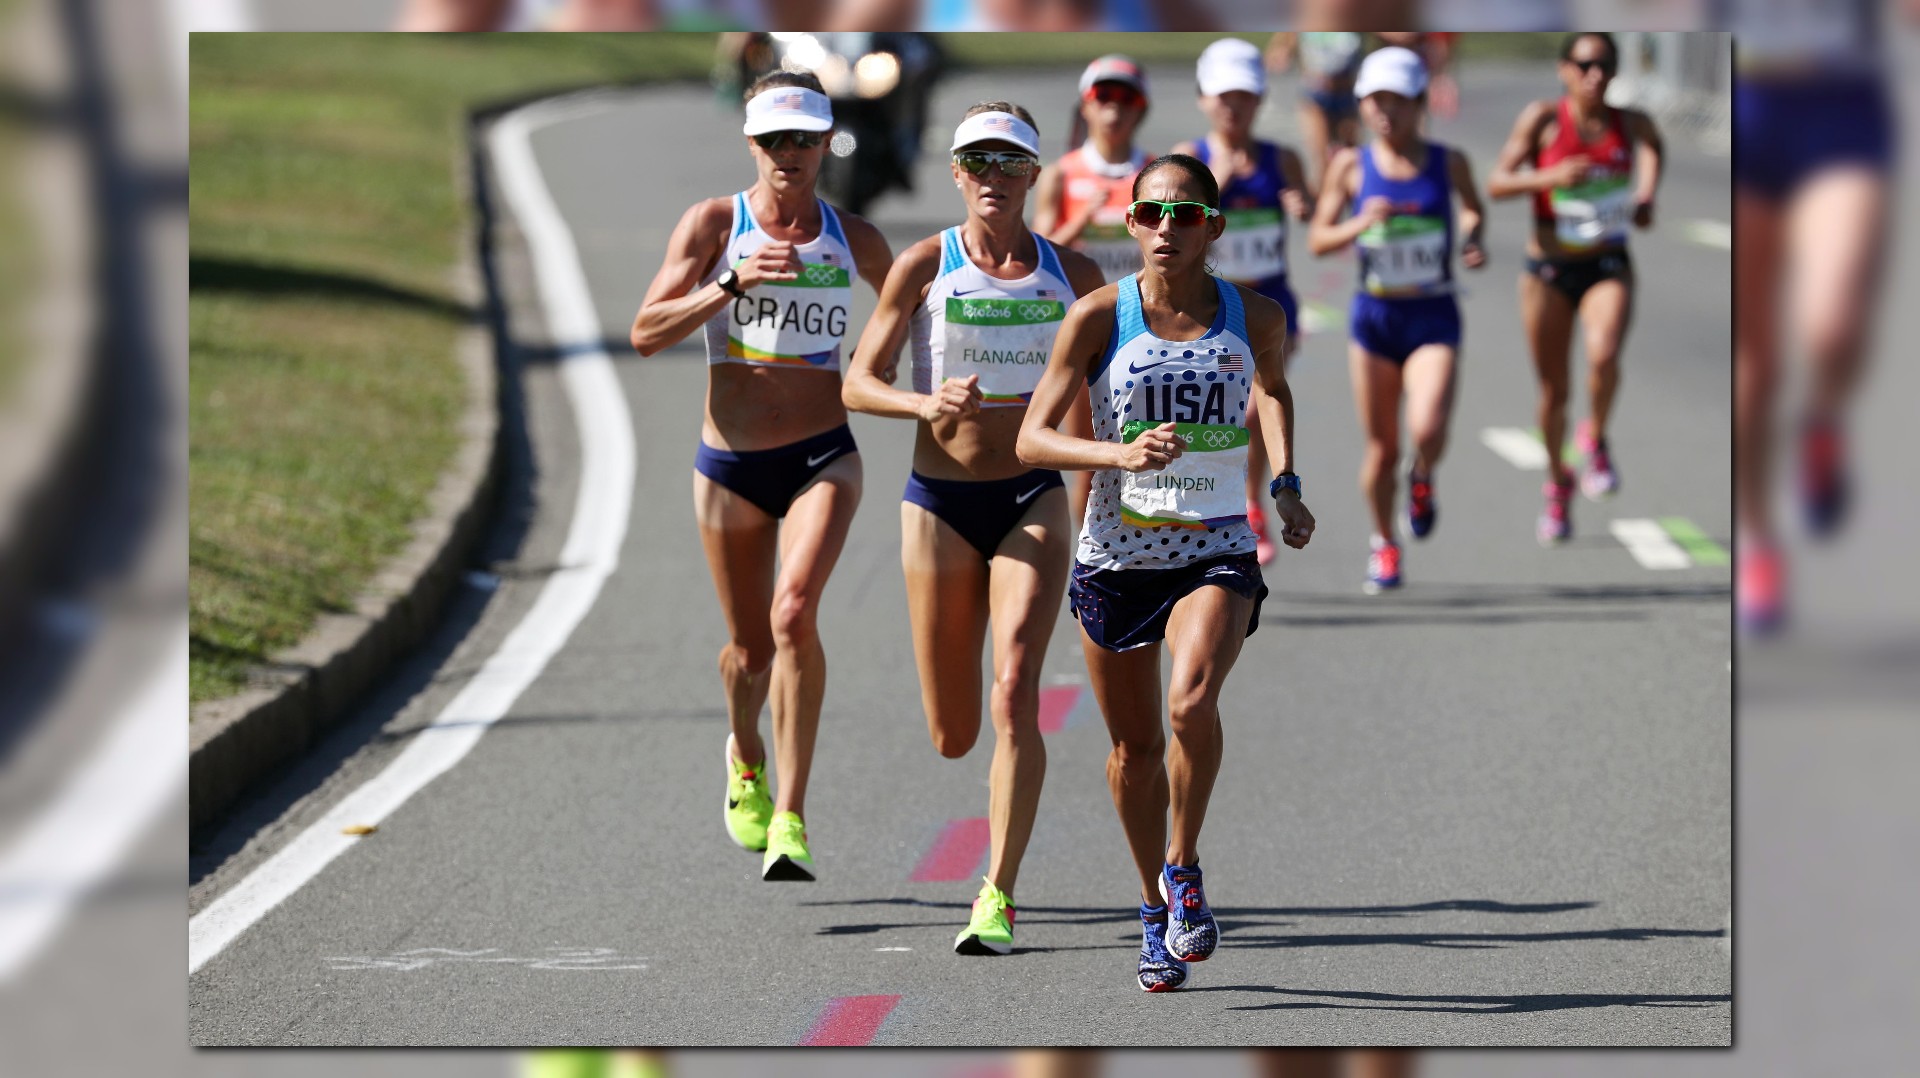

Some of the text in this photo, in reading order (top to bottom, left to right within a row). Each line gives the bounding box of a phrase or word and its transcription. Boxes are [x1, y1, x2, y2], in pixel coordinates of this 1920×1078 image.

[733, 295, 847, 337] CRAGG
[962, 303, 1012, 318] Rio2016
[963, 348, 1047, 365] FLANAGAN
[1145, 382, 1226, 425] USA
[1156, 475, 1215, 491] LINDEN
